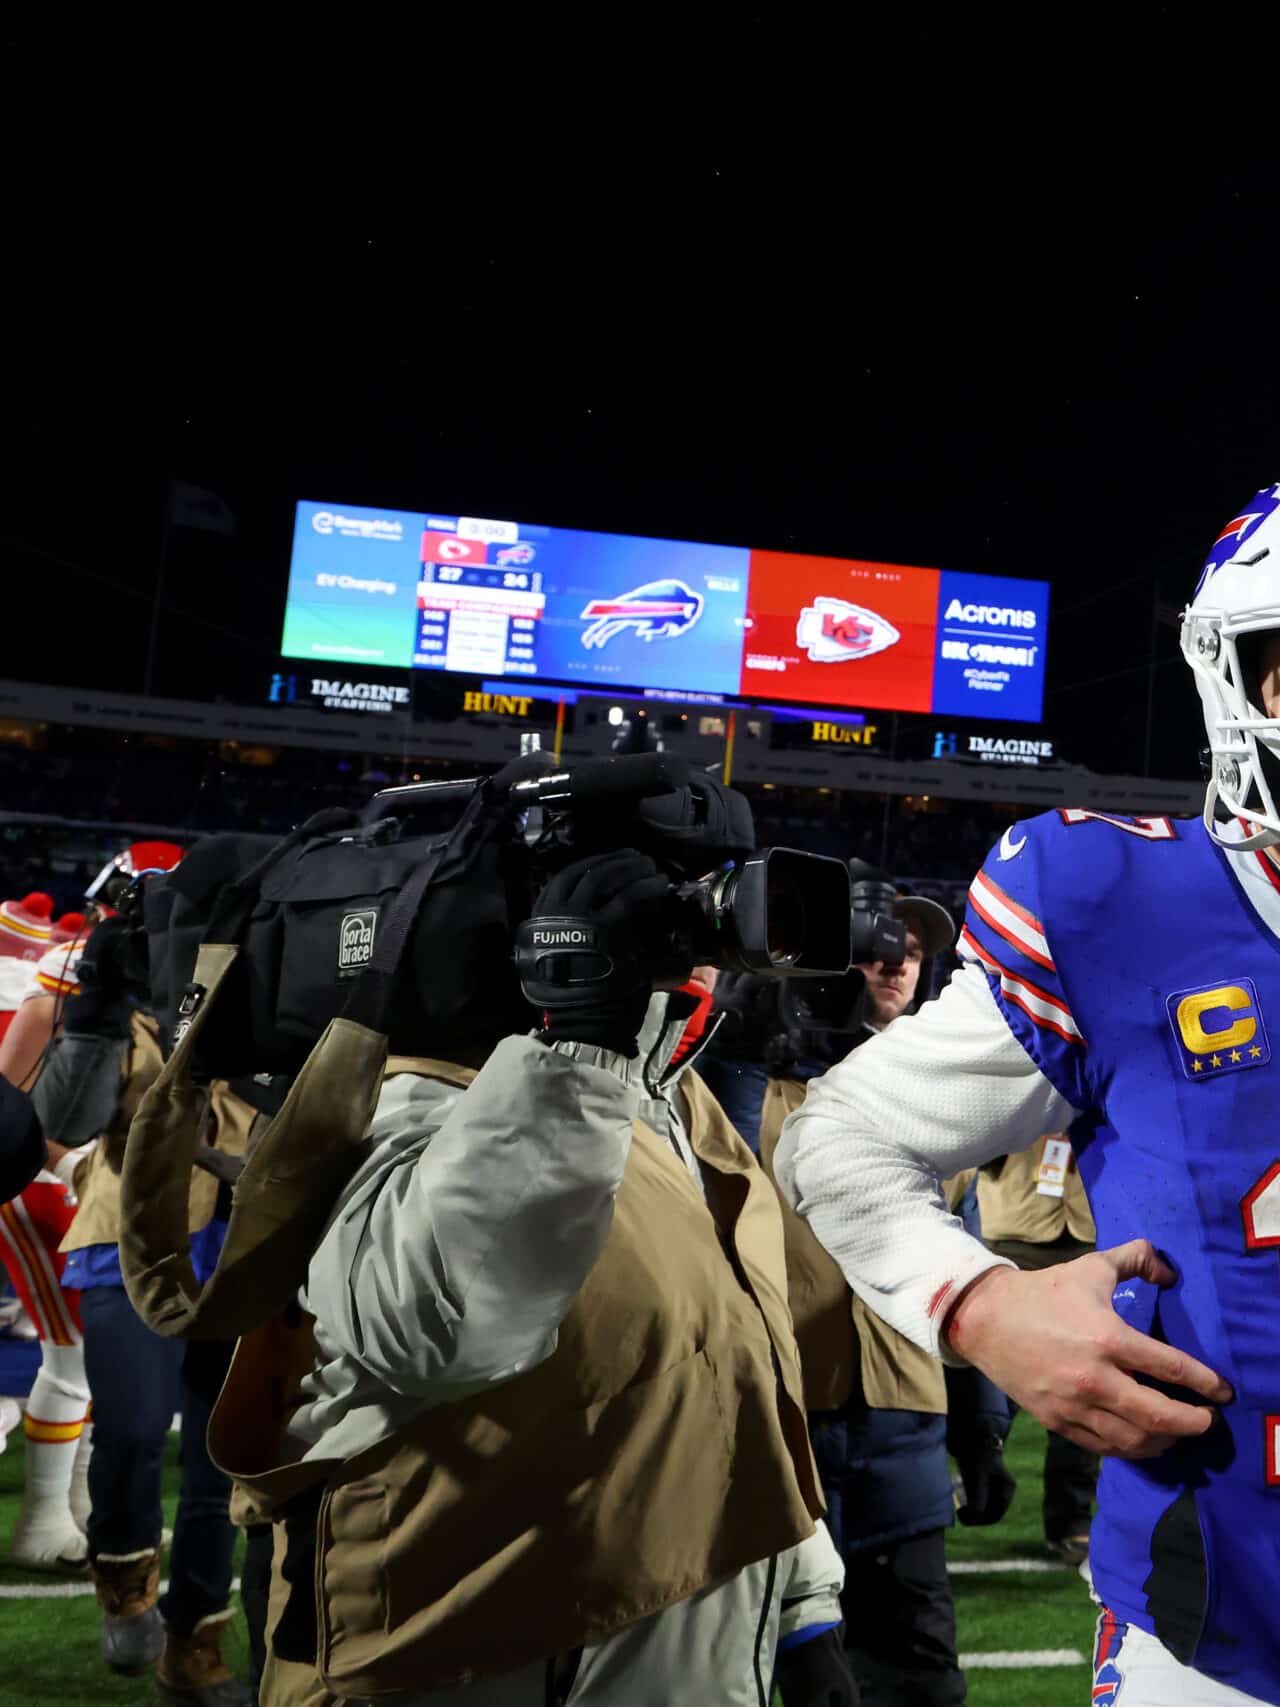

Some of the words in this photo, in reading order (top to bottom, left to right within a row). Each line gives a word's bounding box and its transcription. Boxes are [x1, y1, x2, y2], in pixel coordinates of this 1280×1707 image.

[438, 566, 464, 582] 27
[503, 572, 529, 589] 24
[944, 598, 1037, 629] Acronis
[311, 679, 410, 703] IMAGINE
[463, 691, 534, 717] HUNT
[811, 721, 876, 745] HUNT
[968, 736, 1053, 757] IMAGINE
[1176, 985, 1257, 1056] C
